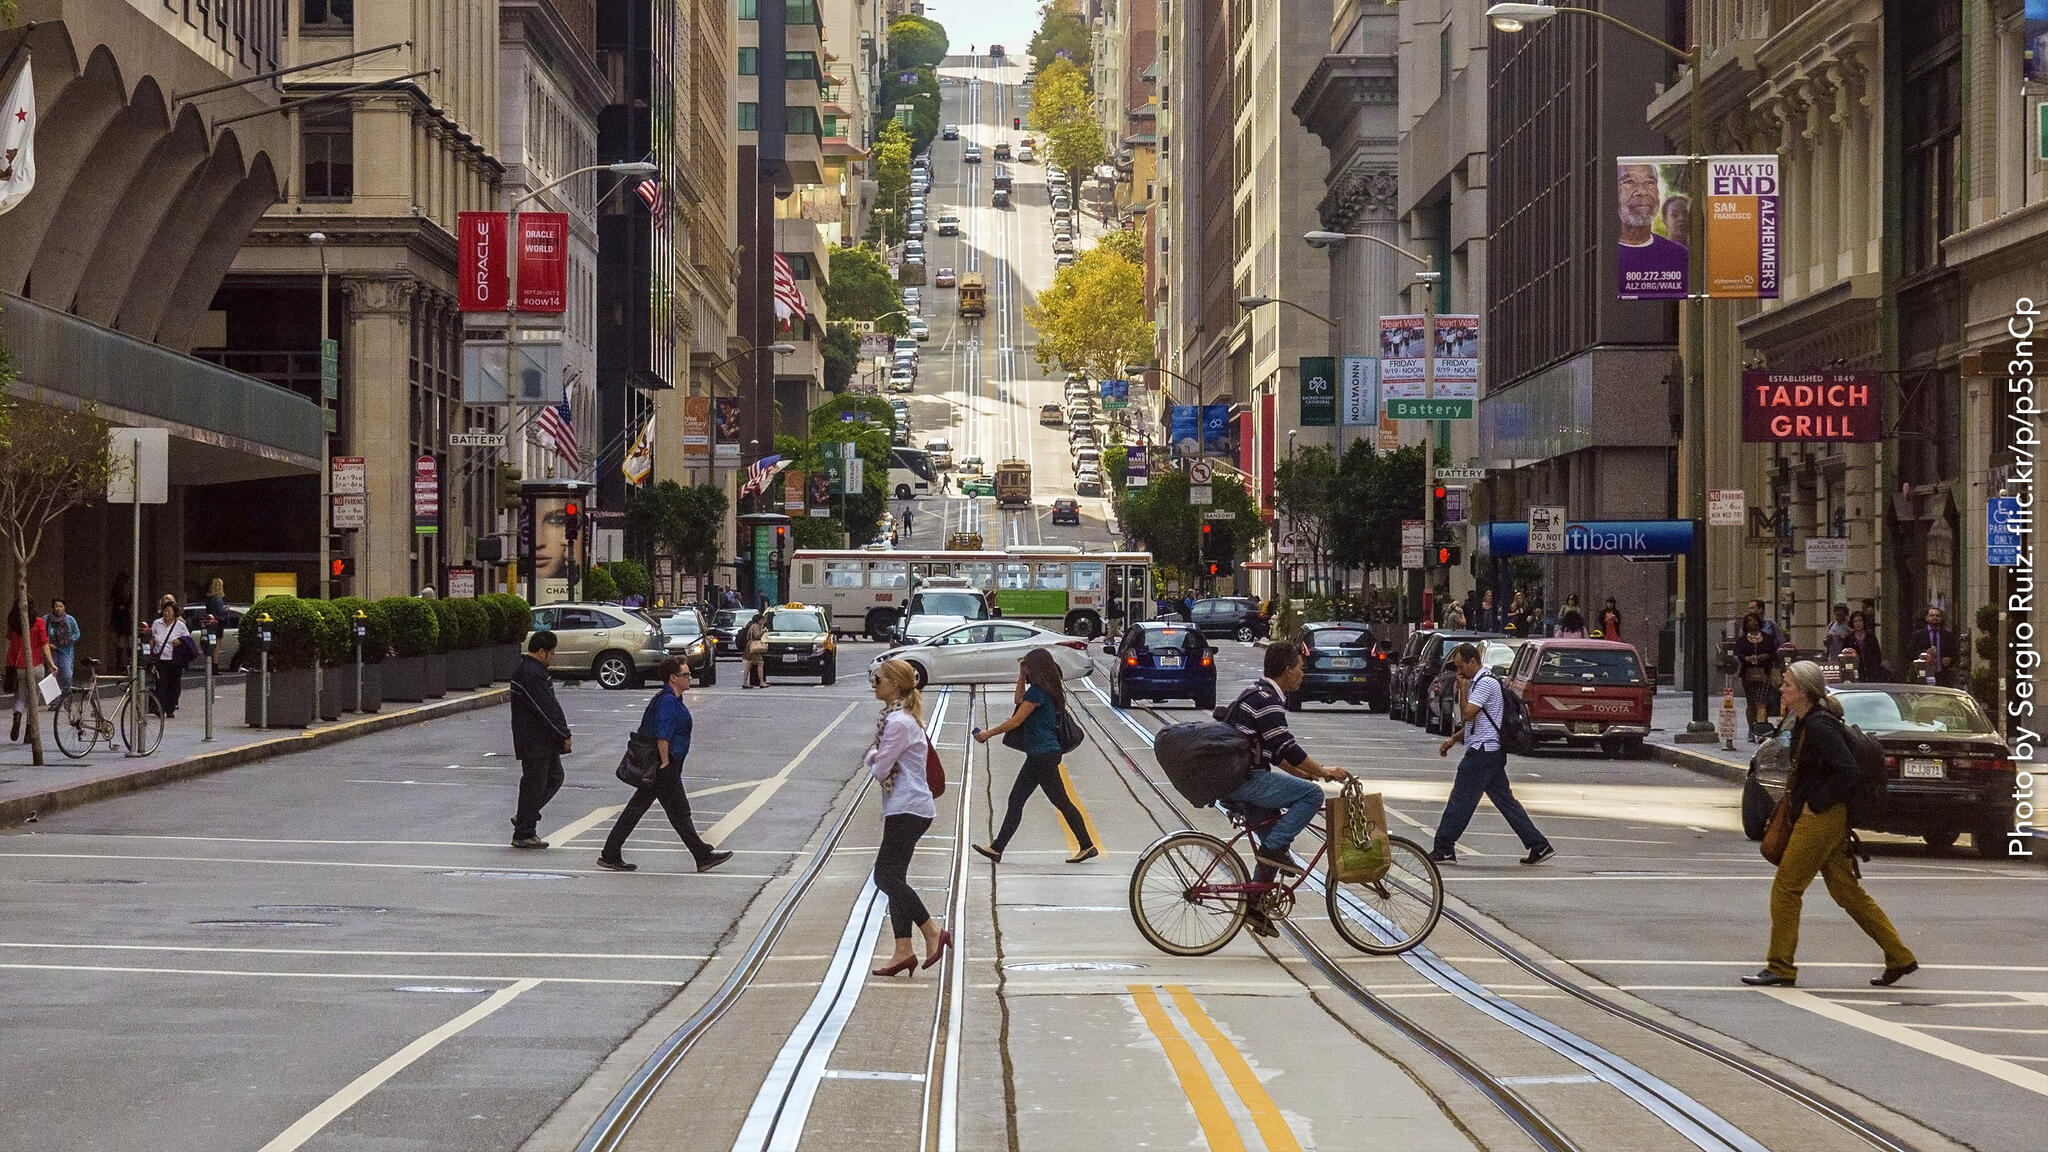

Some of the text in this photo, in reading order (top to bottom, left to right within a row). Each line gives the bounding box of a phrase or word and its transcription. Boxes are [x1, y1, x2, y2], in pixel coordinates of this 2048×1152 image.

[1714, 164, 1774, 176] WALK TO
[1714, 176, 1775, 195] END
[1714, 202, 1736, 212] SAN
[526, 230, 554, 238] ORACLE
[1762, 200, 1775, 288] ALZHEIMER'S
[478, 222, 488, 301] ORACLE
[1626, 271, 1681, 280] 800.272.3900
[1380, 320, 1403, 328] Heart
[1352, 361, 1360, 421] INNOVATION
[1756, 385, 1868, 407] TADICH
[1398, 404, 1462, 417] Battery
[1771, 415, 1854, 437] GRILL
[452, 436, 503, 444] BATTERY
[1710, 492, 1719, 500] NO
[1565, 529, 1647, 550] itibank
[1994, 535, 2013, 544] ONLY
